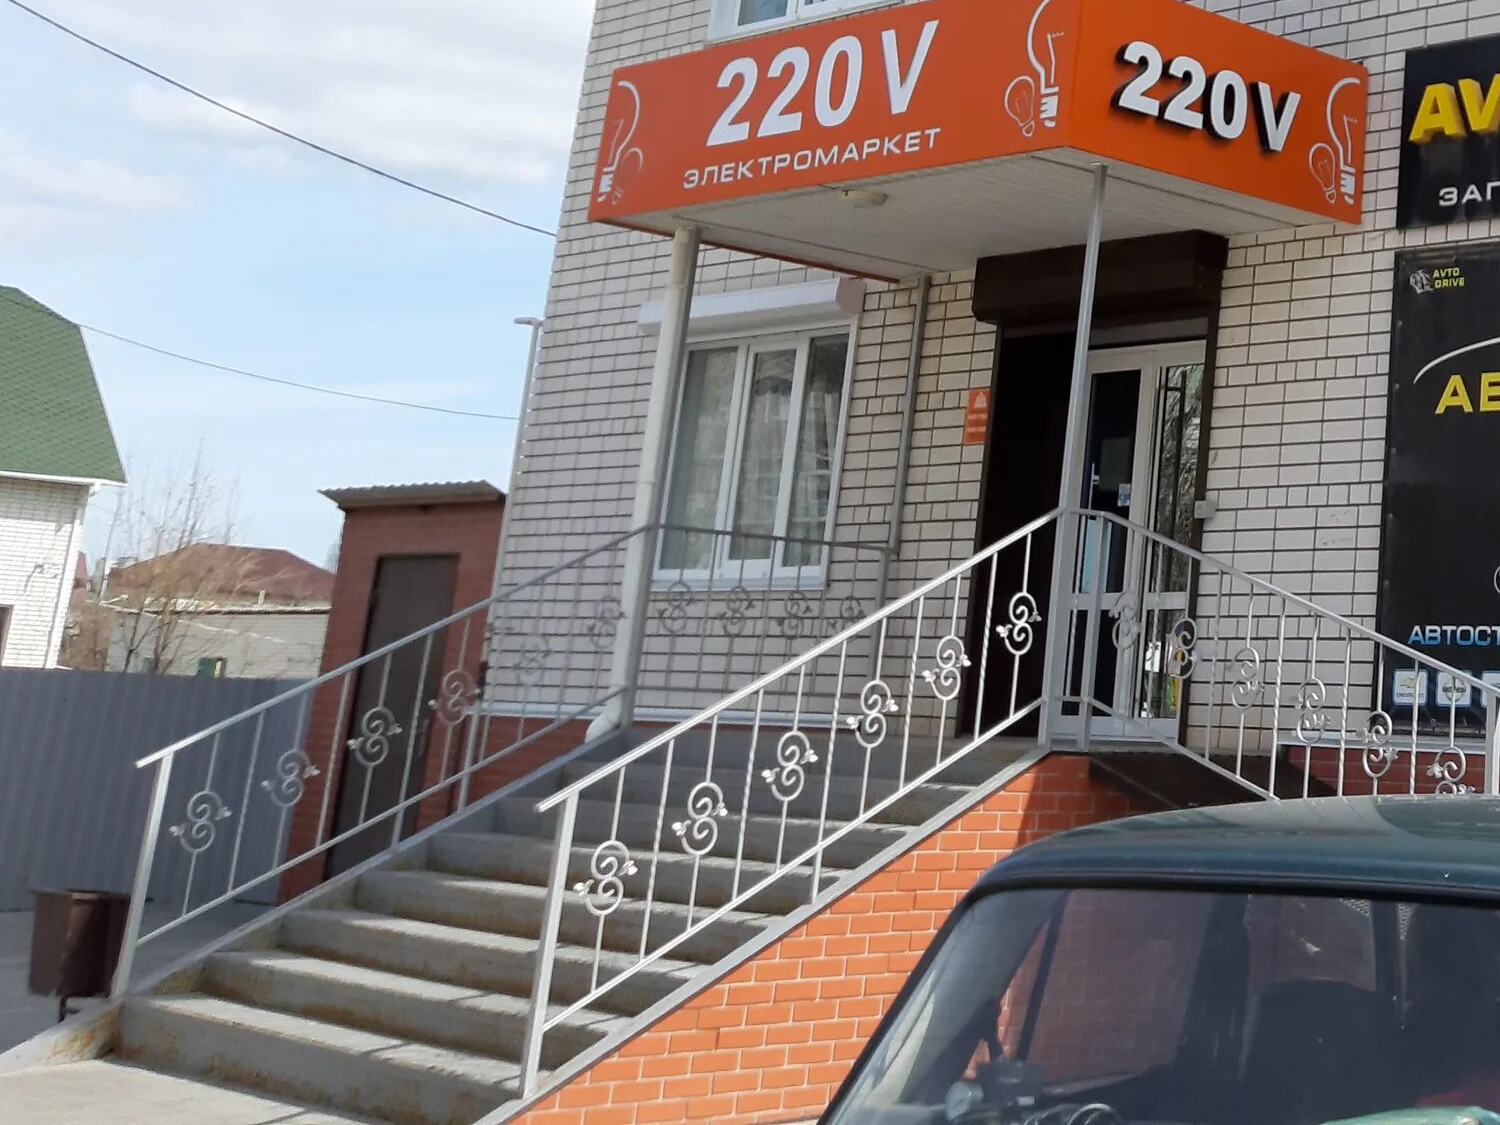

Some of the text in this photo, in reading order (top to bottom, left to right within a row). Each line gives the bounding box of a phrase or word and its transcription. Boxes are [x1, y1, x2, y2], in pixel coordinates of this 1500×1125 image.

[1117, 40, 1302, 152] 220V
[683, 127, 942, 190] ЭЛЕКТРОМАРКЕТ
[1433, 267, 1460, 279] AVTO
[1434, 277, 1465, 289] DRIVE
